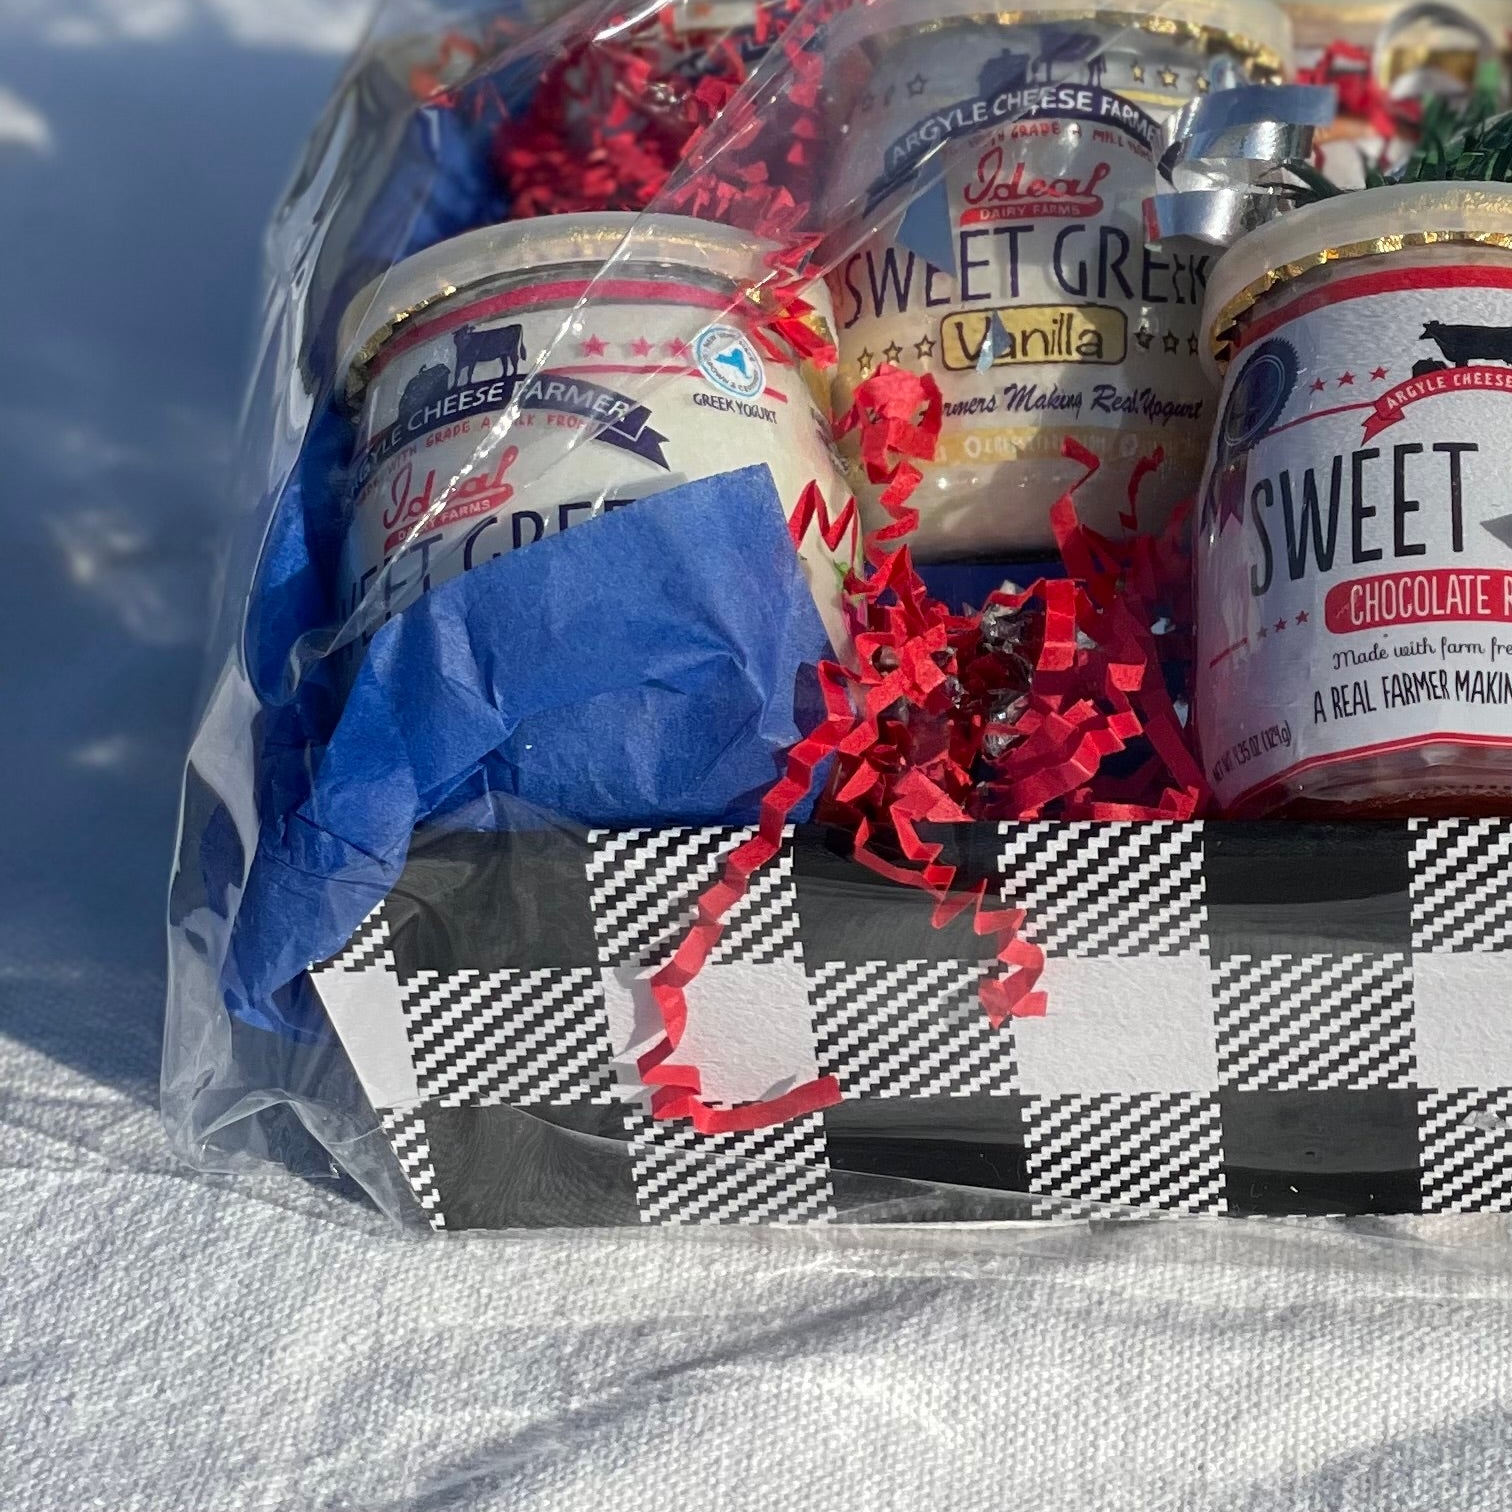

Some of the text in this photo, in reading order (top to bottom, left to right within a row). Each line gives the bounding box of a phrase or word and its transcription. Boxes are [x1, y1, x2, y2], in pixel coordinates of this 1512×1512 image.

[891, 88, 1163, 161] ARGYLE CHEESE FARME
[1011, 120, 1061, 139] GRADE
[963, 146, 1111, 206] Ideal
[979, 204, 1081, 221] DAIRY FARMS
[406, 381, 505, 432] CHEESE
[512, 378, 631, 423] FARMER
[692, 392, 778, 425] GREEK YOGURT
[1003, 382, 1083, 420] Making
[1386, 376, 1447, 411] ARGYLE
[425, 419, 471, 448] GRADE
[480, 417, 493, 431] A
[382, 444, 520, 531] Idal
[442, 499, 491, 522] FARMS
[1250, 441, 1480, 598] SWEET
[1350, 573, 1492, 626] CHOCOLATE
[1332, 643, 1389, 671] Made
[1393, 641, 1438, 659] with
[1441, 636, 1485, 661] farm
[1313, 689, 1328, 725] A
[1331, 679, 1377, 720] REAL
[1380, 668, 1451, 710] FARMER
